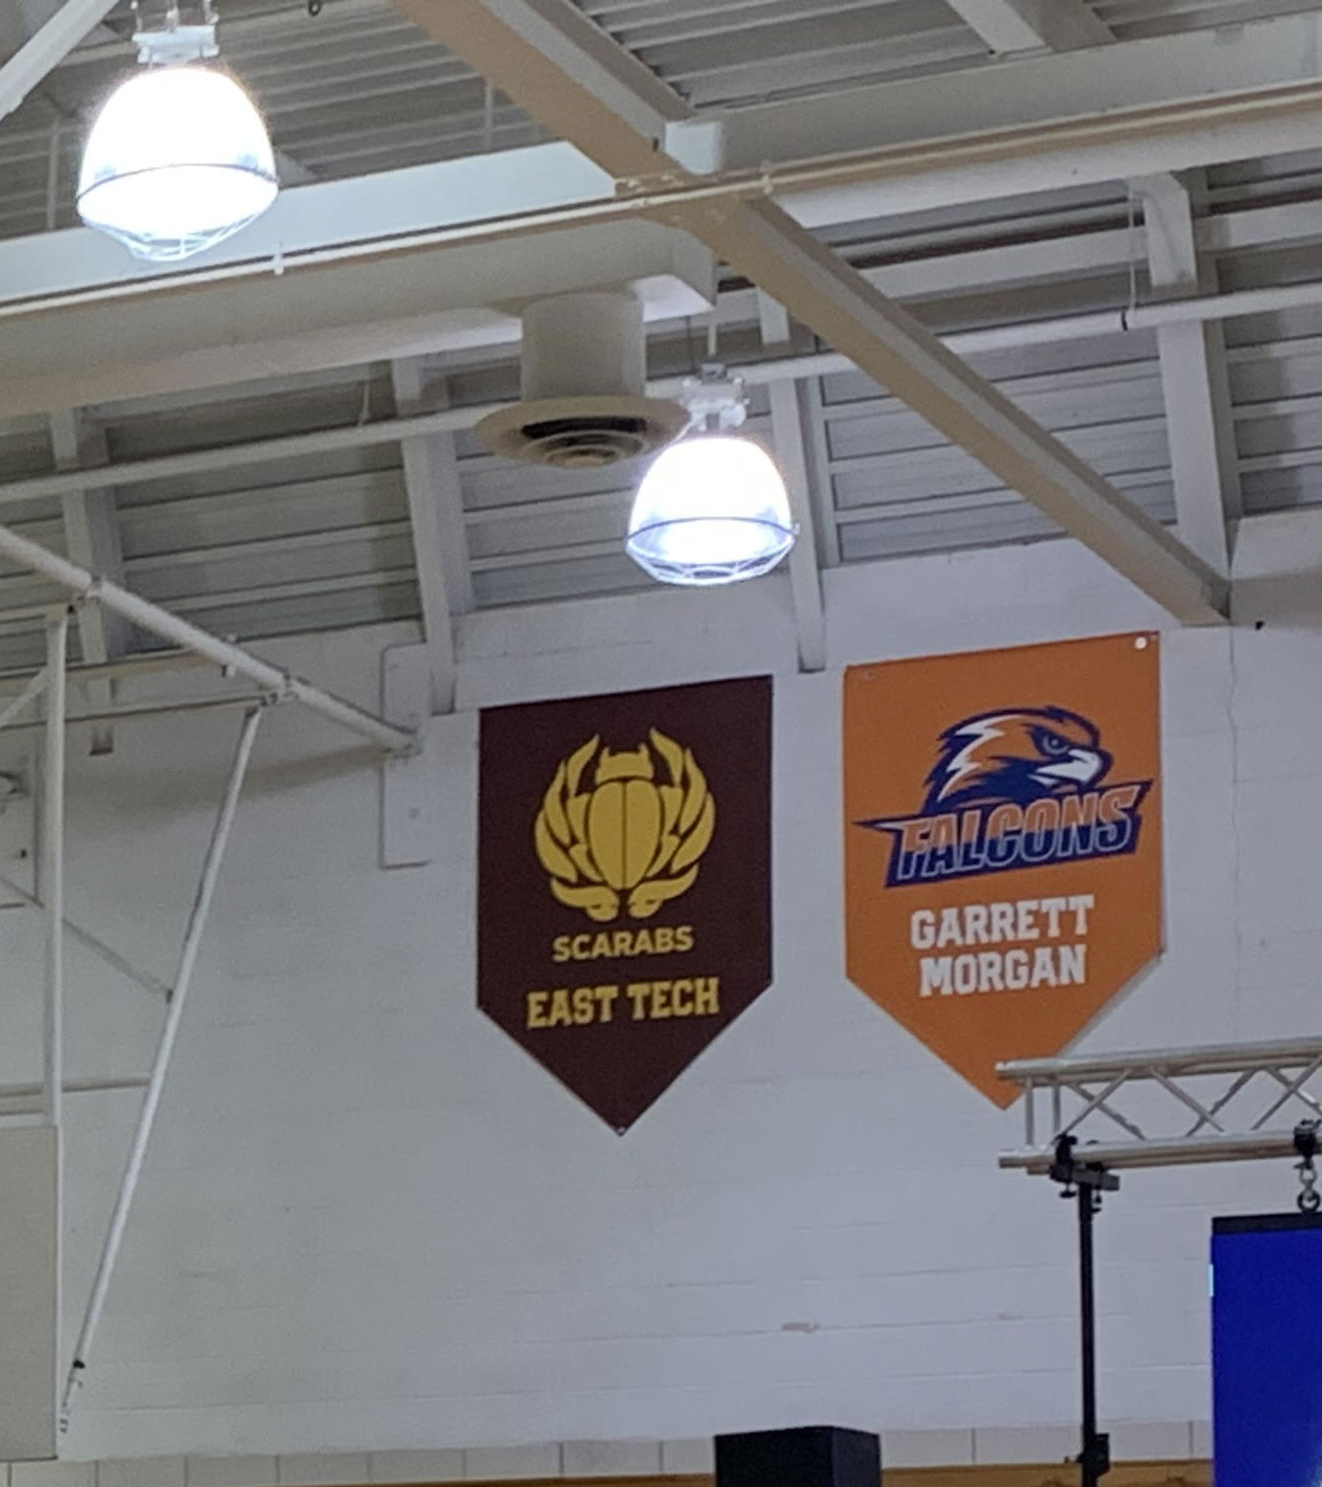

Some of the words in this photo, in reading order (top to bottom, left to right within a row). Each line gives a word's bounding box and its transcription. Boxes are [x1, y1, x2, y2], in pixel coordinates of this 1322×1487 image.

[891, 784, 1142, 881] FALCONS
[552, 926, 694, 962] SCARABS
[910, 894, 1096, 950] GARRETT
[919, 944, 1088, 998] MORGAN
[526, 985, 620, 1029] EAST
[626, 976, 721, 1021] TECH
